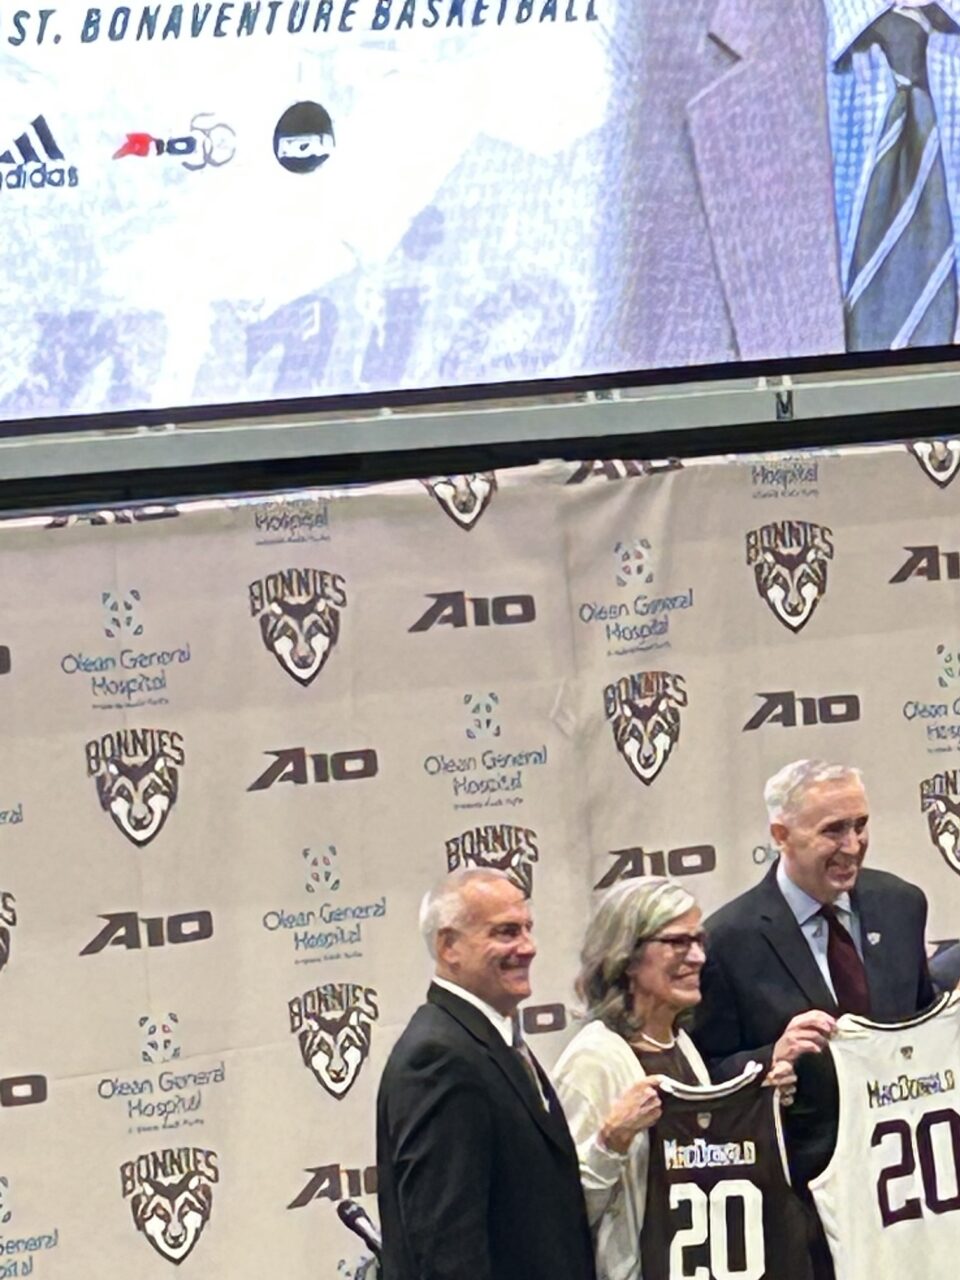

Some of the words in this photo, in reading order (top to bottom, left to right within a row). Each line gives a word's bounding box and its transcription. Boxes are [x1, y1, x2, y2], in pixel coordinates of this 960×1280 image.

[8, 9, 62, 46] ST.
[80, 0, 358, 43] BONAVENTURE
[0, 163, 79, 190] didas
[746, 519, 834, 566] BONNIES
[249, 567, 347, 617] BONNIES
[408, 590, 537, 633] A10
[61, 652, 116, 674] Olean
[120, 643, 190, 671] General
[91, 669, 167, 699] Hospital
[603, 670, 688, 720] BONNIES
[742, 690, 861, 732] A10
[85, 728, 185, 777] BONNIES
[247, 747, 379, 792] A10
[424, 755, 477, 775] Olean
[481, 745, 547, 770] General
[453, 771, 523, 797] Hospital
[445, 824, 538, 874] BONNIES
[593, 844, 717, 890] A10
[79, 909, 214, 957] A10
[263, 909, 315, 931] Olean
[319, 896, 386, 924] General
[288, 982, 379, 1034] BONNIES
[98, 1078, 154, 1099] Olean
[159, 1061, 226, 1092] General
[128, 1090, 202, 1122] Hospital
[120, 1147, 220, 1198] BONNIES
